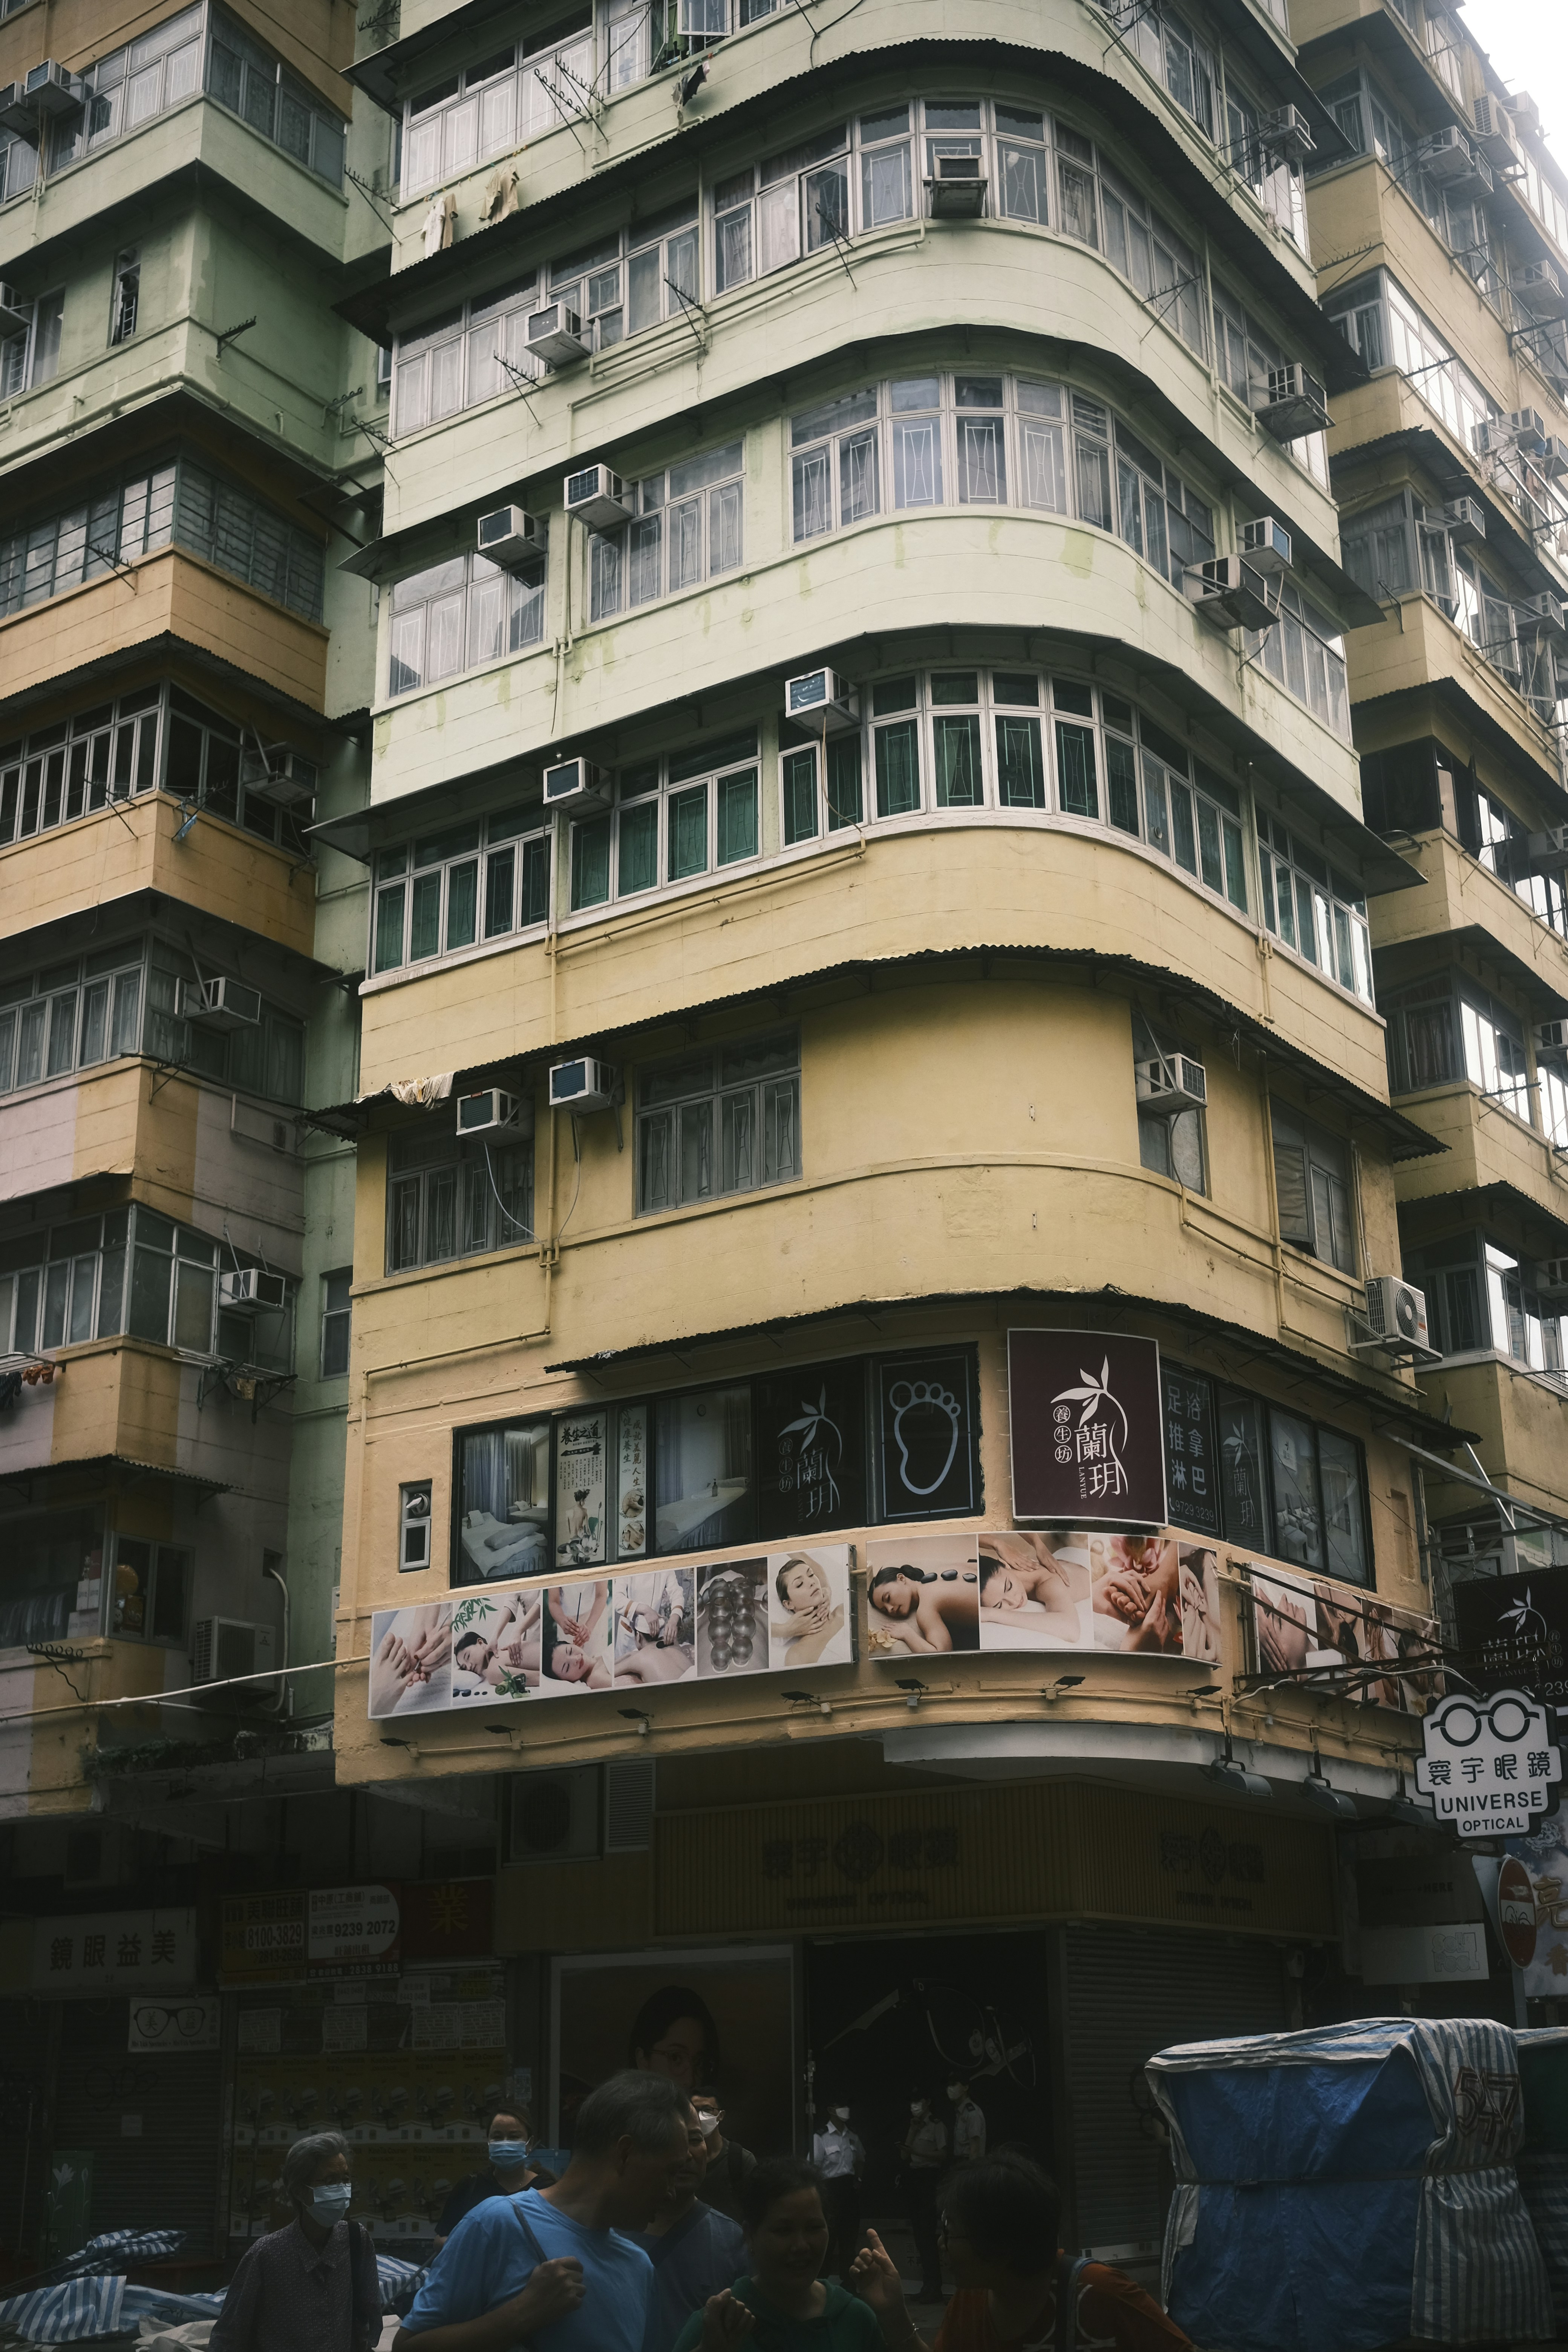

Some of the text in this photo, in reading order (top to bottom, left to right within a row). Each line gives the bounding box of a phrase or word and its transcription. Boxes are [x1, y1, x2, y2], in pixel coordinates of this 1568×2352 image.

[1168, 1387, 1201, 1421] 足浴
[561, 1420, 602, 1445] 養生之道
[623, 1417, 632, 1463] 健康養生
[1054, 1406, 1072, 1462] 養生坊
[1169, 1421, 1204, 1457] 推拿
[632, 1419, 642, 1487] 成就美麗人生
[1074, 1423, 1120, 1498] 蘭玥
[795, 1447, 832, 1519] 蘭玥
[1172, 1459, 1206, 1495] 淋巴
[1233, 1467, 1254, 1527] 蘭玥
[1175, 1500, 1214, 1522] 9729 3239
[1499, 1668, 1528, 1677] LANYUE
[1428, 1752, 1551, 1785] 寰宇眼鏡
[1441, 1791, 1543, 1813] UNIVERSE
[1462, 1817, 1524, 1831] OPTICAL
[1423, 1882, 1454, 1893] HERE
[427, 1885, 470, 1935] 業
[786, 1891, 928, 1911] UNIVERSE OPTICAL
[248, 1923, 302, 1948] 8100-3829
[334, 1920, 395, 1937] 9239 2072
[259, 1948, 303, 1964] 2813-2628
[349, 1965, 372, 1975] 2838
[375, 1963, 398, 1972] 9188
[145, 2011, 196, 2031] 美 益
